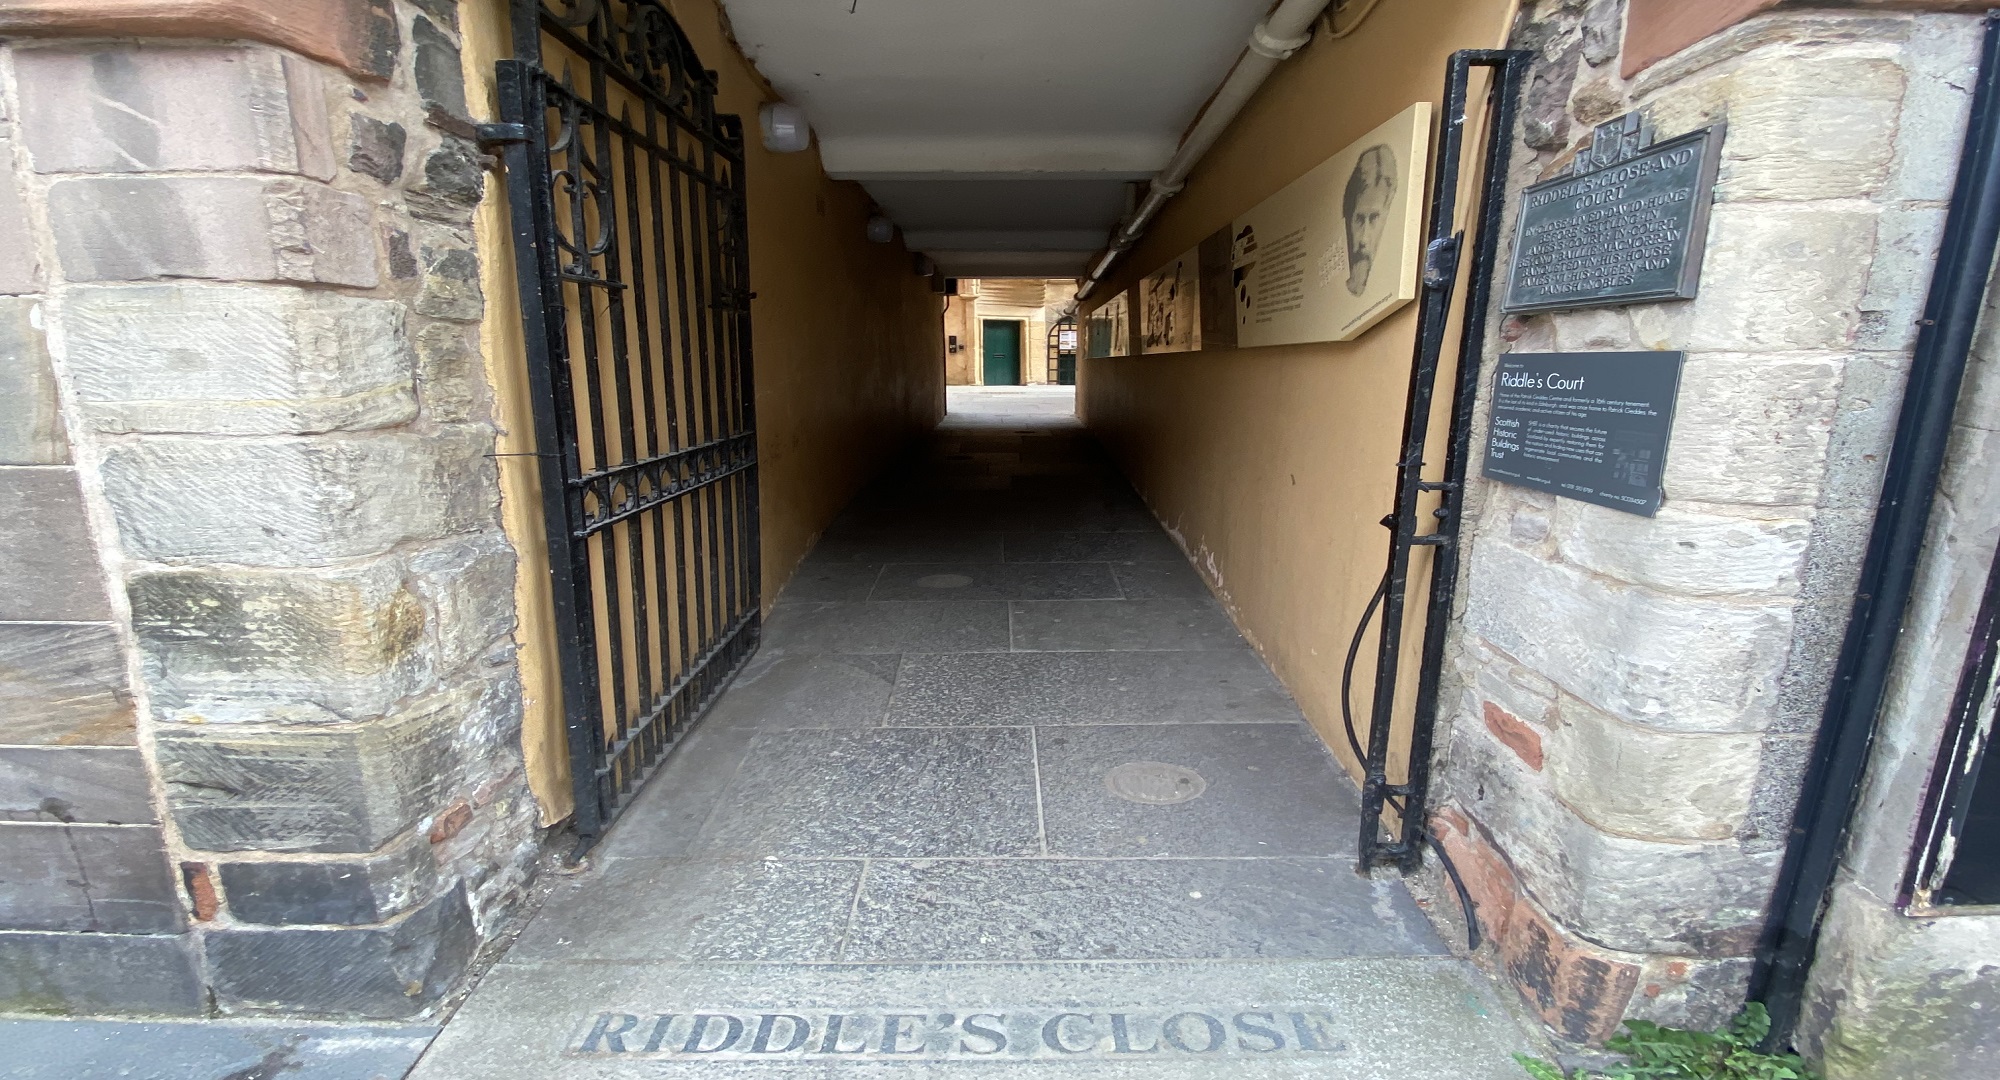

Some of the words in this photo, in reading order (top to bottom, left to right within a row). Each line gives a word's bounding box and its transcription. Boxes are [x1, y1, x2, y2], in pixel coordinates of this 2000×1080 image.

[1600, 162, 1650, 188] CLOSE
[1653, 149, 1693, 172] AND
[1574, 184, 1628, 210] COURT
[1607, 200, 1644, 218] DAVID
[1647, 188, 1689, 208] HUME
[1631, 217, 1677, 236] COURT
[1626, 244, 1672, 261] HOUSE
[1595, 263, 1637, 278] QUEEN
[1640, 257, 1670, 272] AND
[1501, 372, 1543, 389] Riddle's
[1546, 373, 1585, 391] Court
[1494, 416, 1520, 428] Scottish
[1493, 427, 1518, 439] Historic
[1490, 447, 1505, 459] Trust
[1491, 438, 1520, 452] Buildings
[578, 1011, 1008, 1055] RIDDLE'S
[1041, 1010, 1347, 1055] CLOSE
